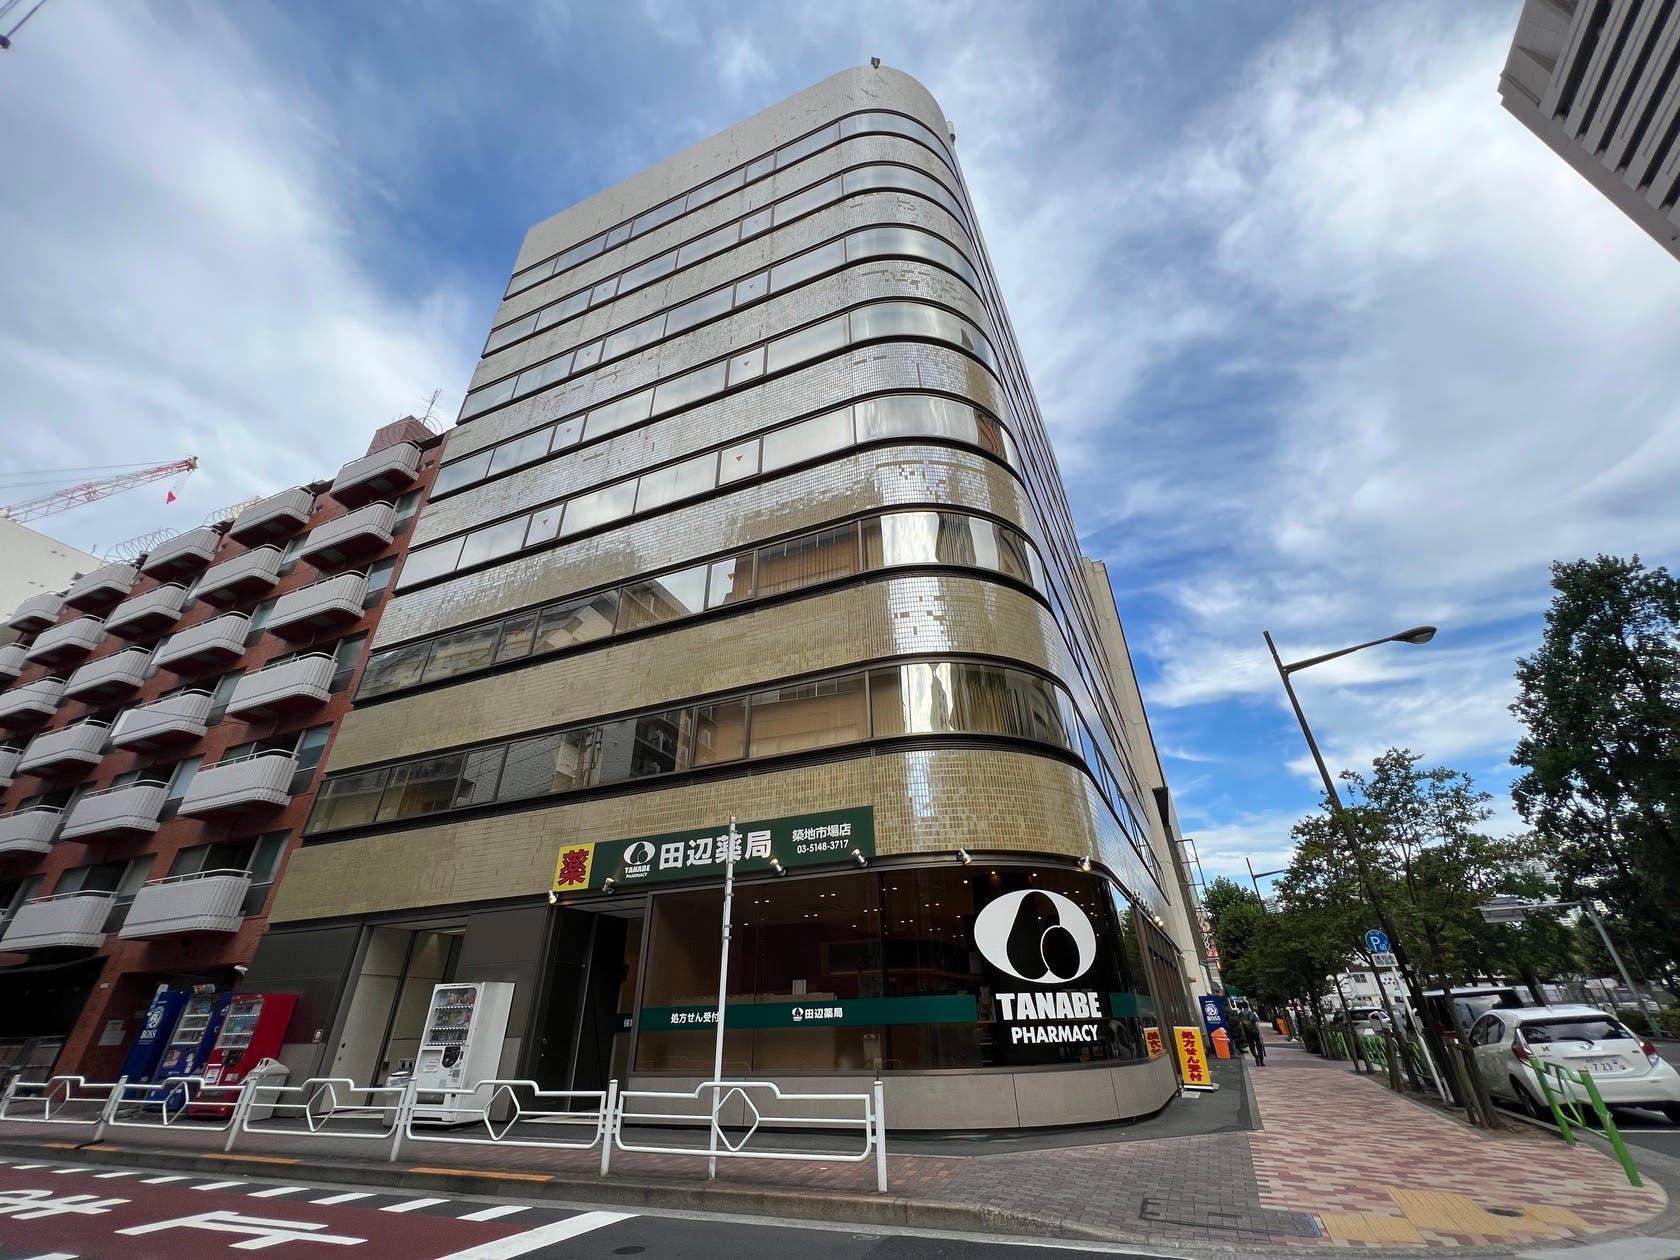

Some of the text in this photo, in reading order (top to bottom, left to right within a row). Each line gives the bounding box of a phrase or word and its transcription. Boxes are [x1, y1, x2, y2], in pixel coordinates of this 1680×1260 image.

[792, 822, 851, 842] 築地市場店
[659, 829, 772, 870] 田辺薬局
[797, 839, 849, 854] 03-5148-3717
[557, 848, 590, 887] 薬
[624, 864, 651, 874] TANABE
[1370, 936, 1381, 951] P
[804, 1007, 843, 1019] 田辺薬局
[996, 992, 1102, 1020] TANABE
[1011, 1024, 1098, 1044] PHARMACY
[1181, 1031, 1203, 1081] 処方せん受付
